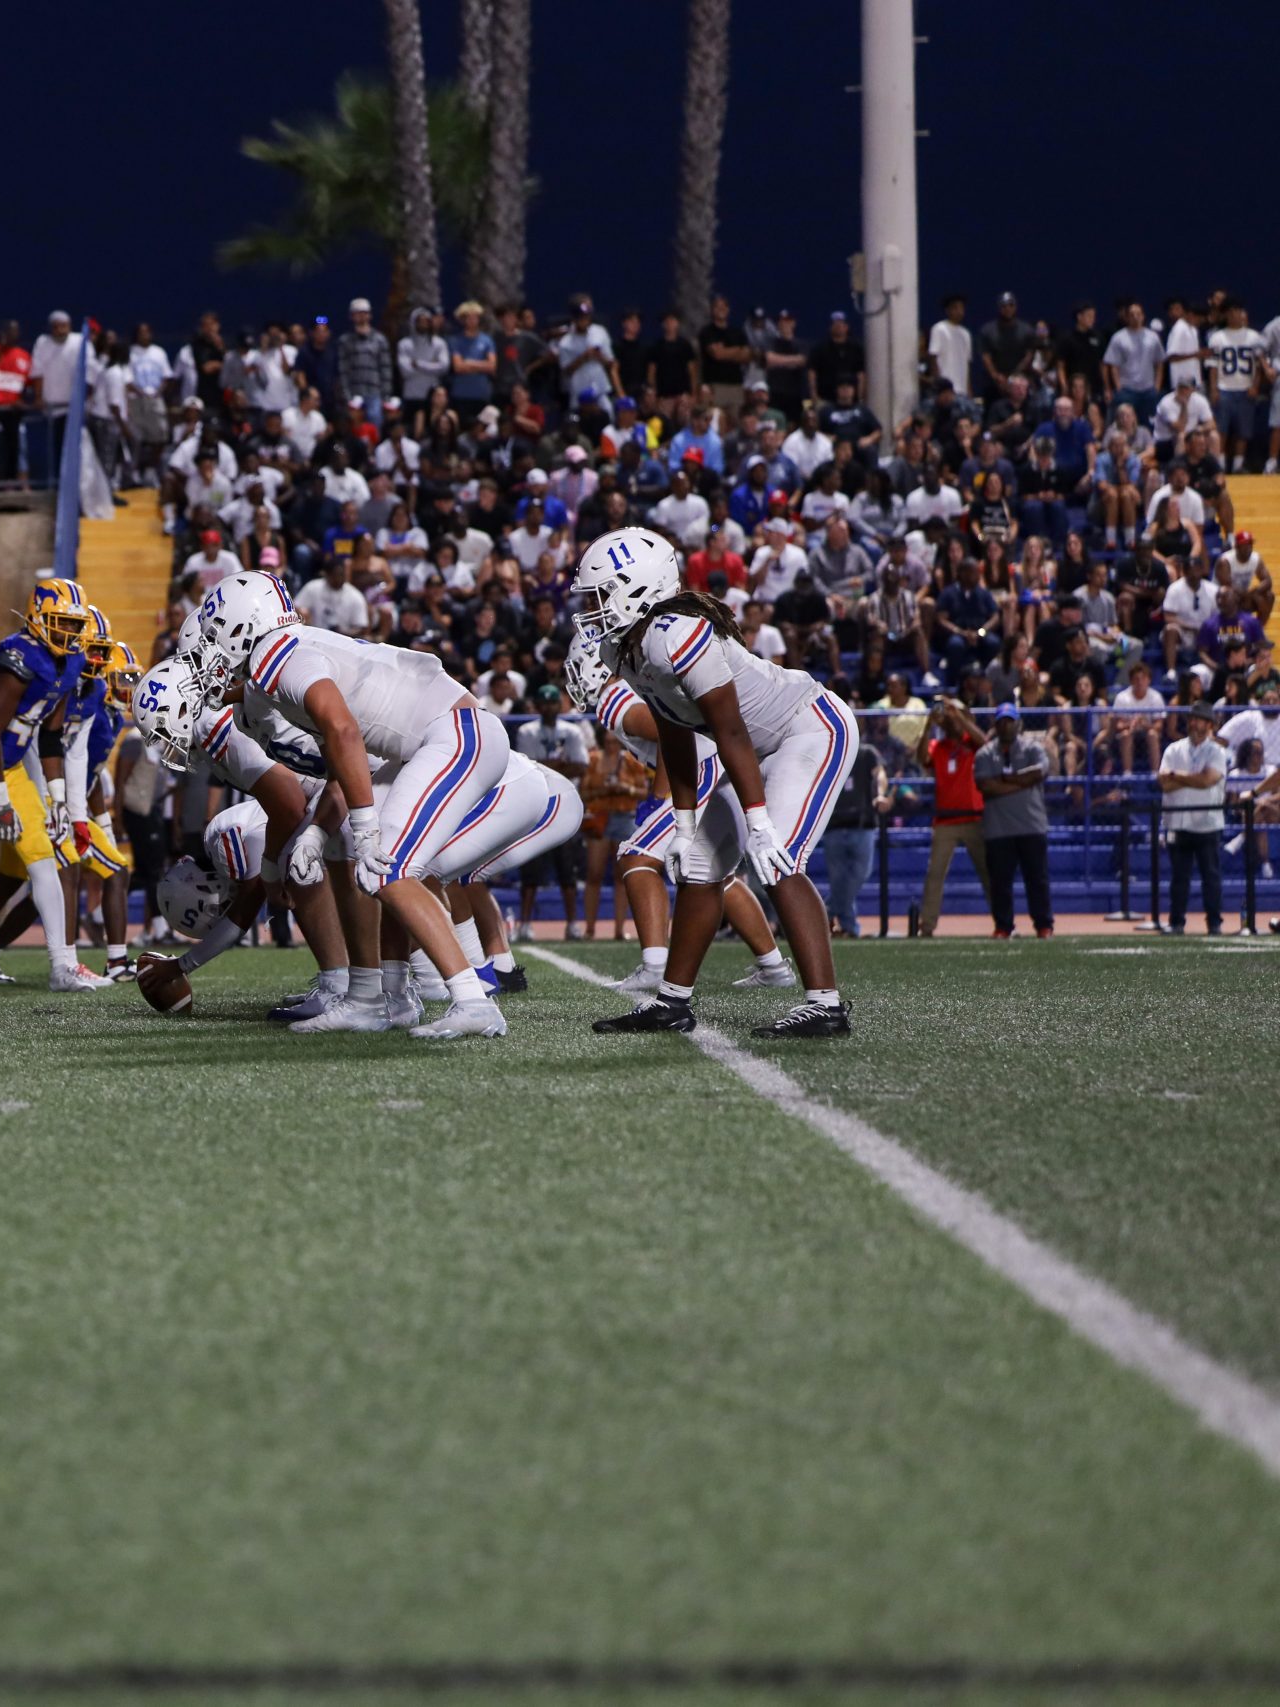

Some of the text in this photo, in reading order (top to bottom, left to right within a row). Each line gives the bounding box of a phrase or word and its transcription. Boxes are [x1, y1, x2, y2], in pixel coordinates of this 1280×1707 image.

[607, 542, 636, 571] 11
[204, 587, 225, 618] 51
[277, 613, 298, 626] Ridd
[654, 615, 678, 632] 11
[138, 679, 168, 713] 54
